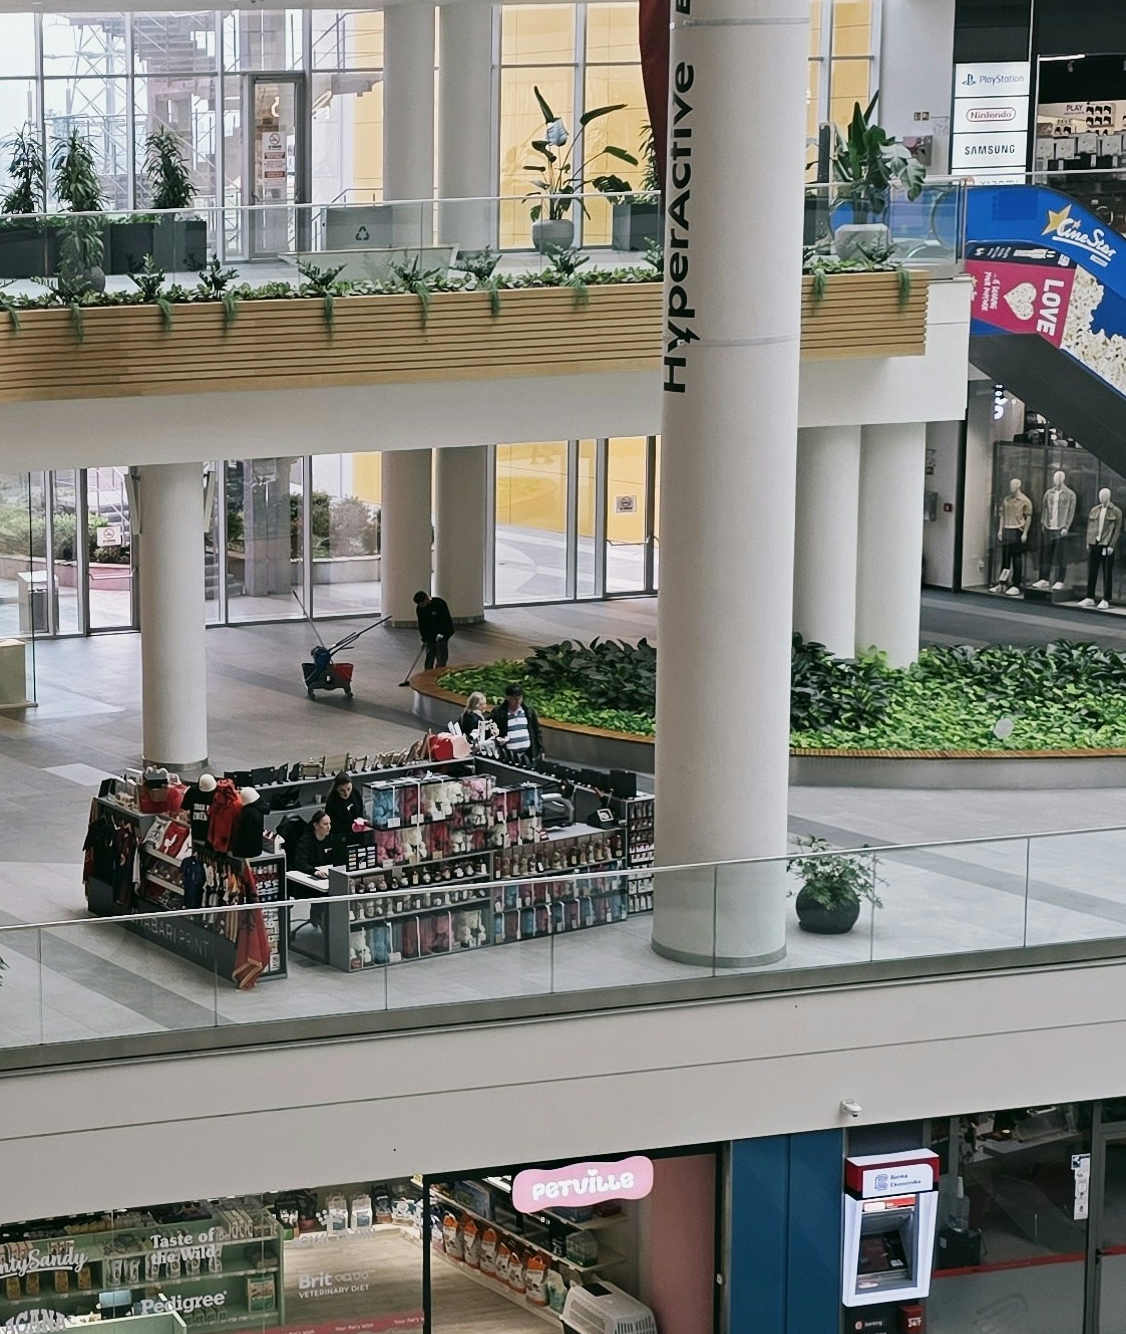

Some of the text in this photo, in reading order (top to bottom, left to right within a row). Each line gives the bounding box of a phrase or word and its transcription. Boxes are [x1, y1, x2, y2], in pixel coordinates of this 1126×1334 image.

[979, 75, 1024, 86] PlayStation
[970, 111, 1012, 119] Nintendo
[964, 144, 1015, 156] SAMSUNG
[1056, 217, 1117, 257] CineStar
[1036, 278, 1065, 337] LOVE
[150, 1227, 214, 1249] Taste of
[151, 1244, 215, 1265] the Wild
[298, 1272, 333, 1289] Brit
[299, 1284, 370, 1299] VETERINARY DIET
[140, 1293, 225, 1316] Pedigree
